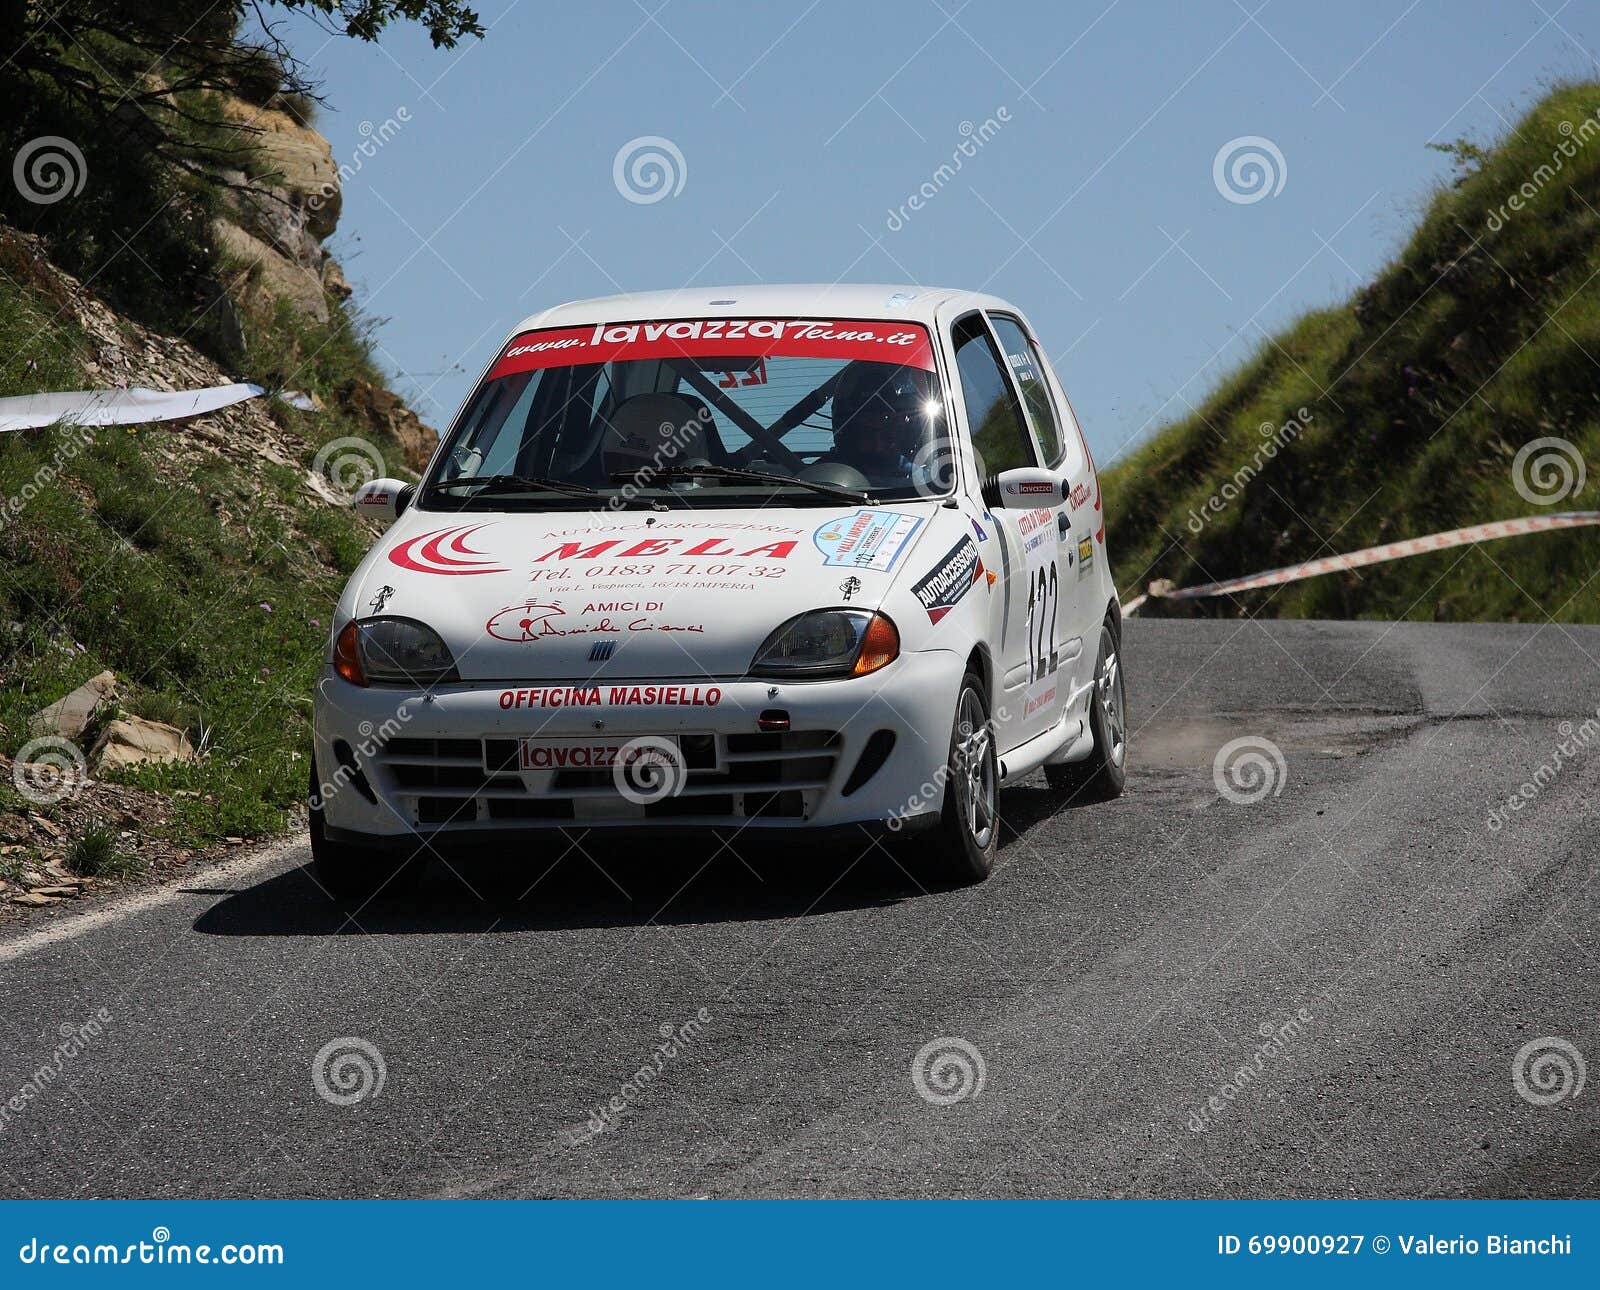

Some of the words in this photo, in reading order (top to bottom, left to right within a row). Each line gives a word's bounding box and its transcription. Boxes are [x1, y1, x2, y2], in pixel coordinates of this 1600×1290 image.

[1020, 483, 1052, 493] lavazza
[543, 522, 805, 539] AUTOCARROZZERIA
[531, 538, 799, 563] MELA
[529, 567, 571, 582] Tel.
[585, 564, 655, 578] 0183
[693, 582, 756, 590] IMPERIA
[581, 602, 639, 616] AMICI
[645, 602, 664, 612] DI
[1027, 560, 1059, 685] 122
[500, 689, 602, 710] OFFICINA
[608, 687, 722, 707] MASIELLO
[522, 740, 644, 768] lavazza
